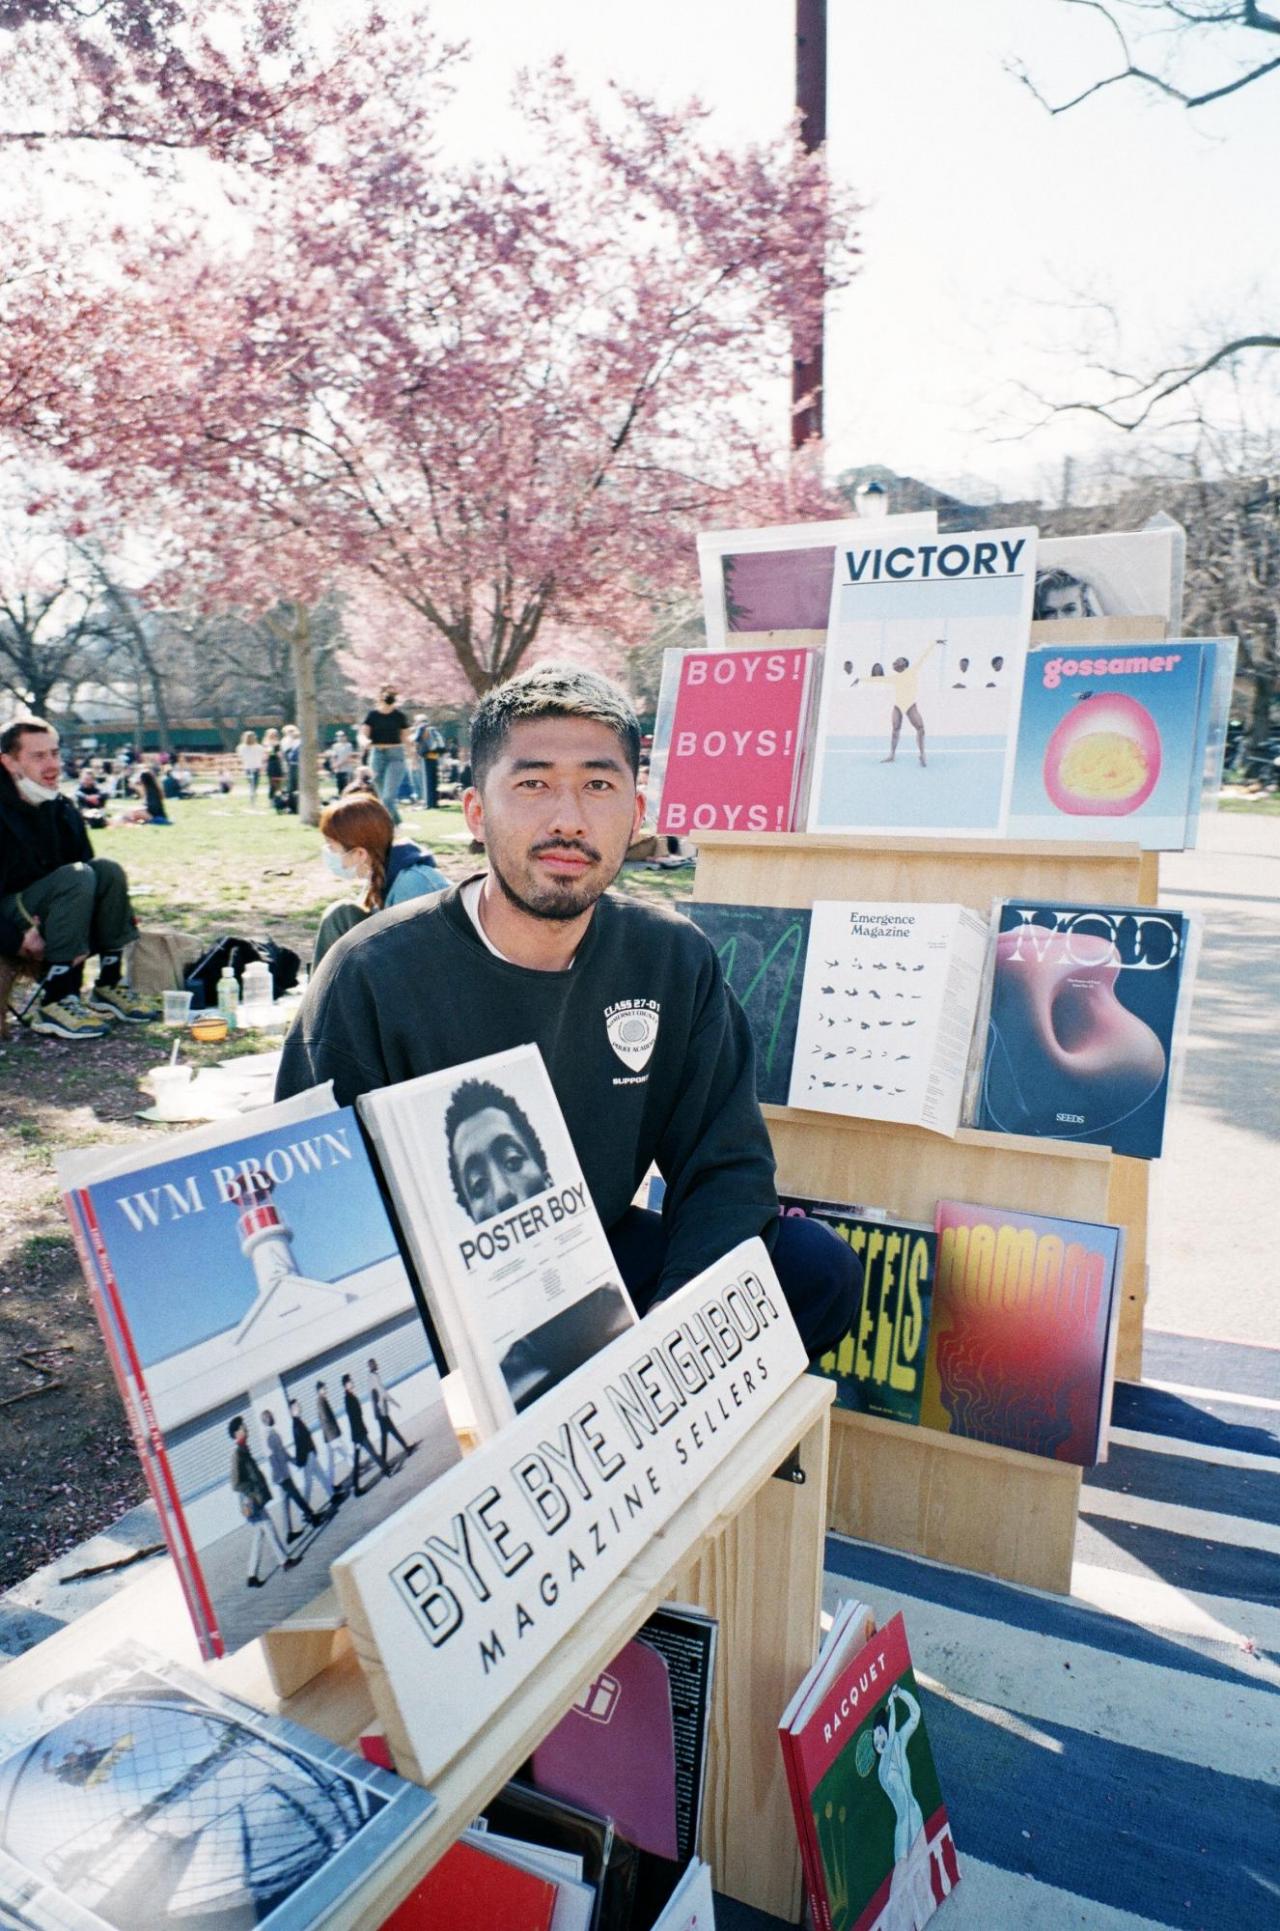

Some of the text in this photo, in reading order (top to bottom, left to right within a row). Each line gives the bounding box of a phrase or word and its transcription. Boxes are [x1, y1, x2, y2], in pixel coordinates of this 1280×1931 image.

[846, 539, 1026, 581] VICTORY
[687, 655, 801, 686] BOYS!
[1043, 654, 1182, 689] gossamer
[676, 730, 793, 758] BOYS!
[665, 803, 784, 832] BOYS!
[850, 912, 916, 926] Emergence
[851, 925, 910, 939] Magazine
[1006, 910, 1179, 970] MOLD
[603, 999, 660, 1018] CLASS 27-01
[1056, 1113, 1086, 1124] SEEDS
[116, 1128, 353, 1233] WM BROWN
[459, 1203, 549, 1270] POSTER
[546, 1182, 589, 1223] BOY
[388, 1269, 779, 1649] BYE BYE NEIGHBOR
[477, 1357, 768, 1675] MAGAZINE SELLERS
[823, 1653, 887, 1744] RACQUET
